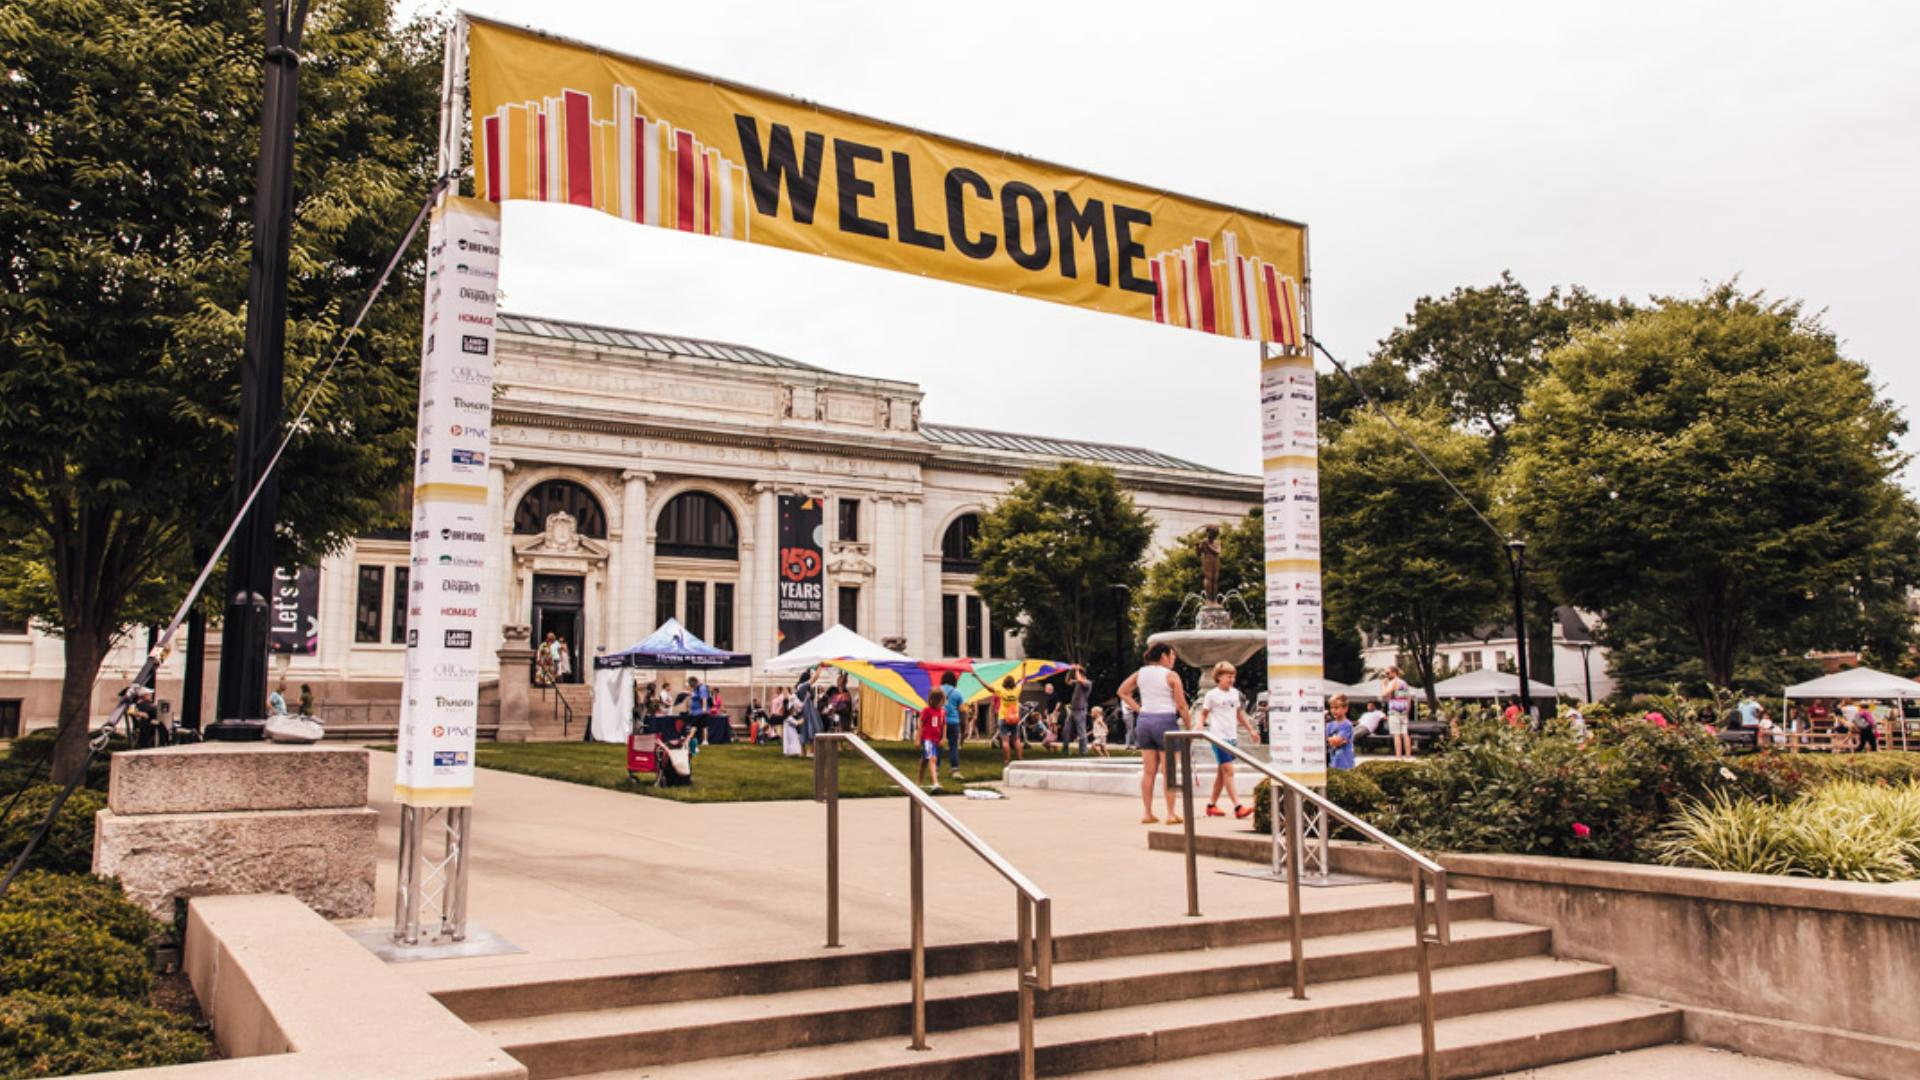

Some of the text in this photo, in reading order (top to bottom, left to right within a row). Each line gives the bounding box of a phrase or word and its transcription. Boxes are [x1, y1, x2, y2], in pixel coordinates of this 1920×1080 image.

[734, 113, 1158, 295] WELCOME
[458, 313, 494, 327] HOMAGE
[780, 546, 822, 582] 150
[780, 582, 822, 599] YEARS
[271, 587, 300, 632] Let's
[780, 600, 821, 610] SERVING THE
[440, 607, 478, 618] HOMAGE
[779, 610, 822, 621] COMMUNITY
[447, 726, 473, 737] PNC
